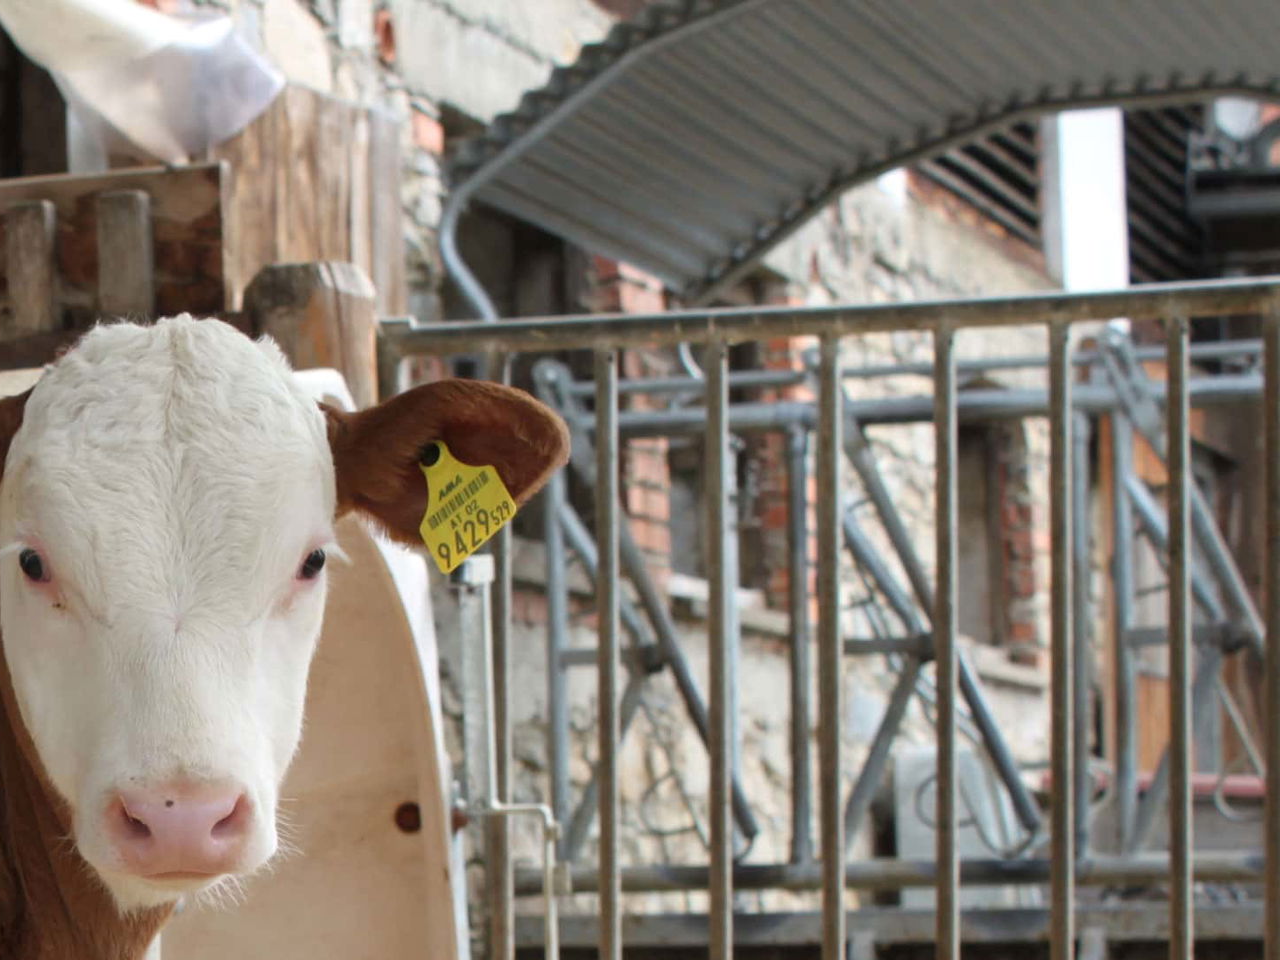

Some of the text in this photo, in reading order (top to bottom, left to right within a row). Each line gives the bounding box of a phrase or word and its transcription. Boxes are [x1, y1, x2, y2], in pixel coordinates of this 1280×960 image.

[465, 500, 480, 515] 02
[438, 501, 511, 568] 9429 529
